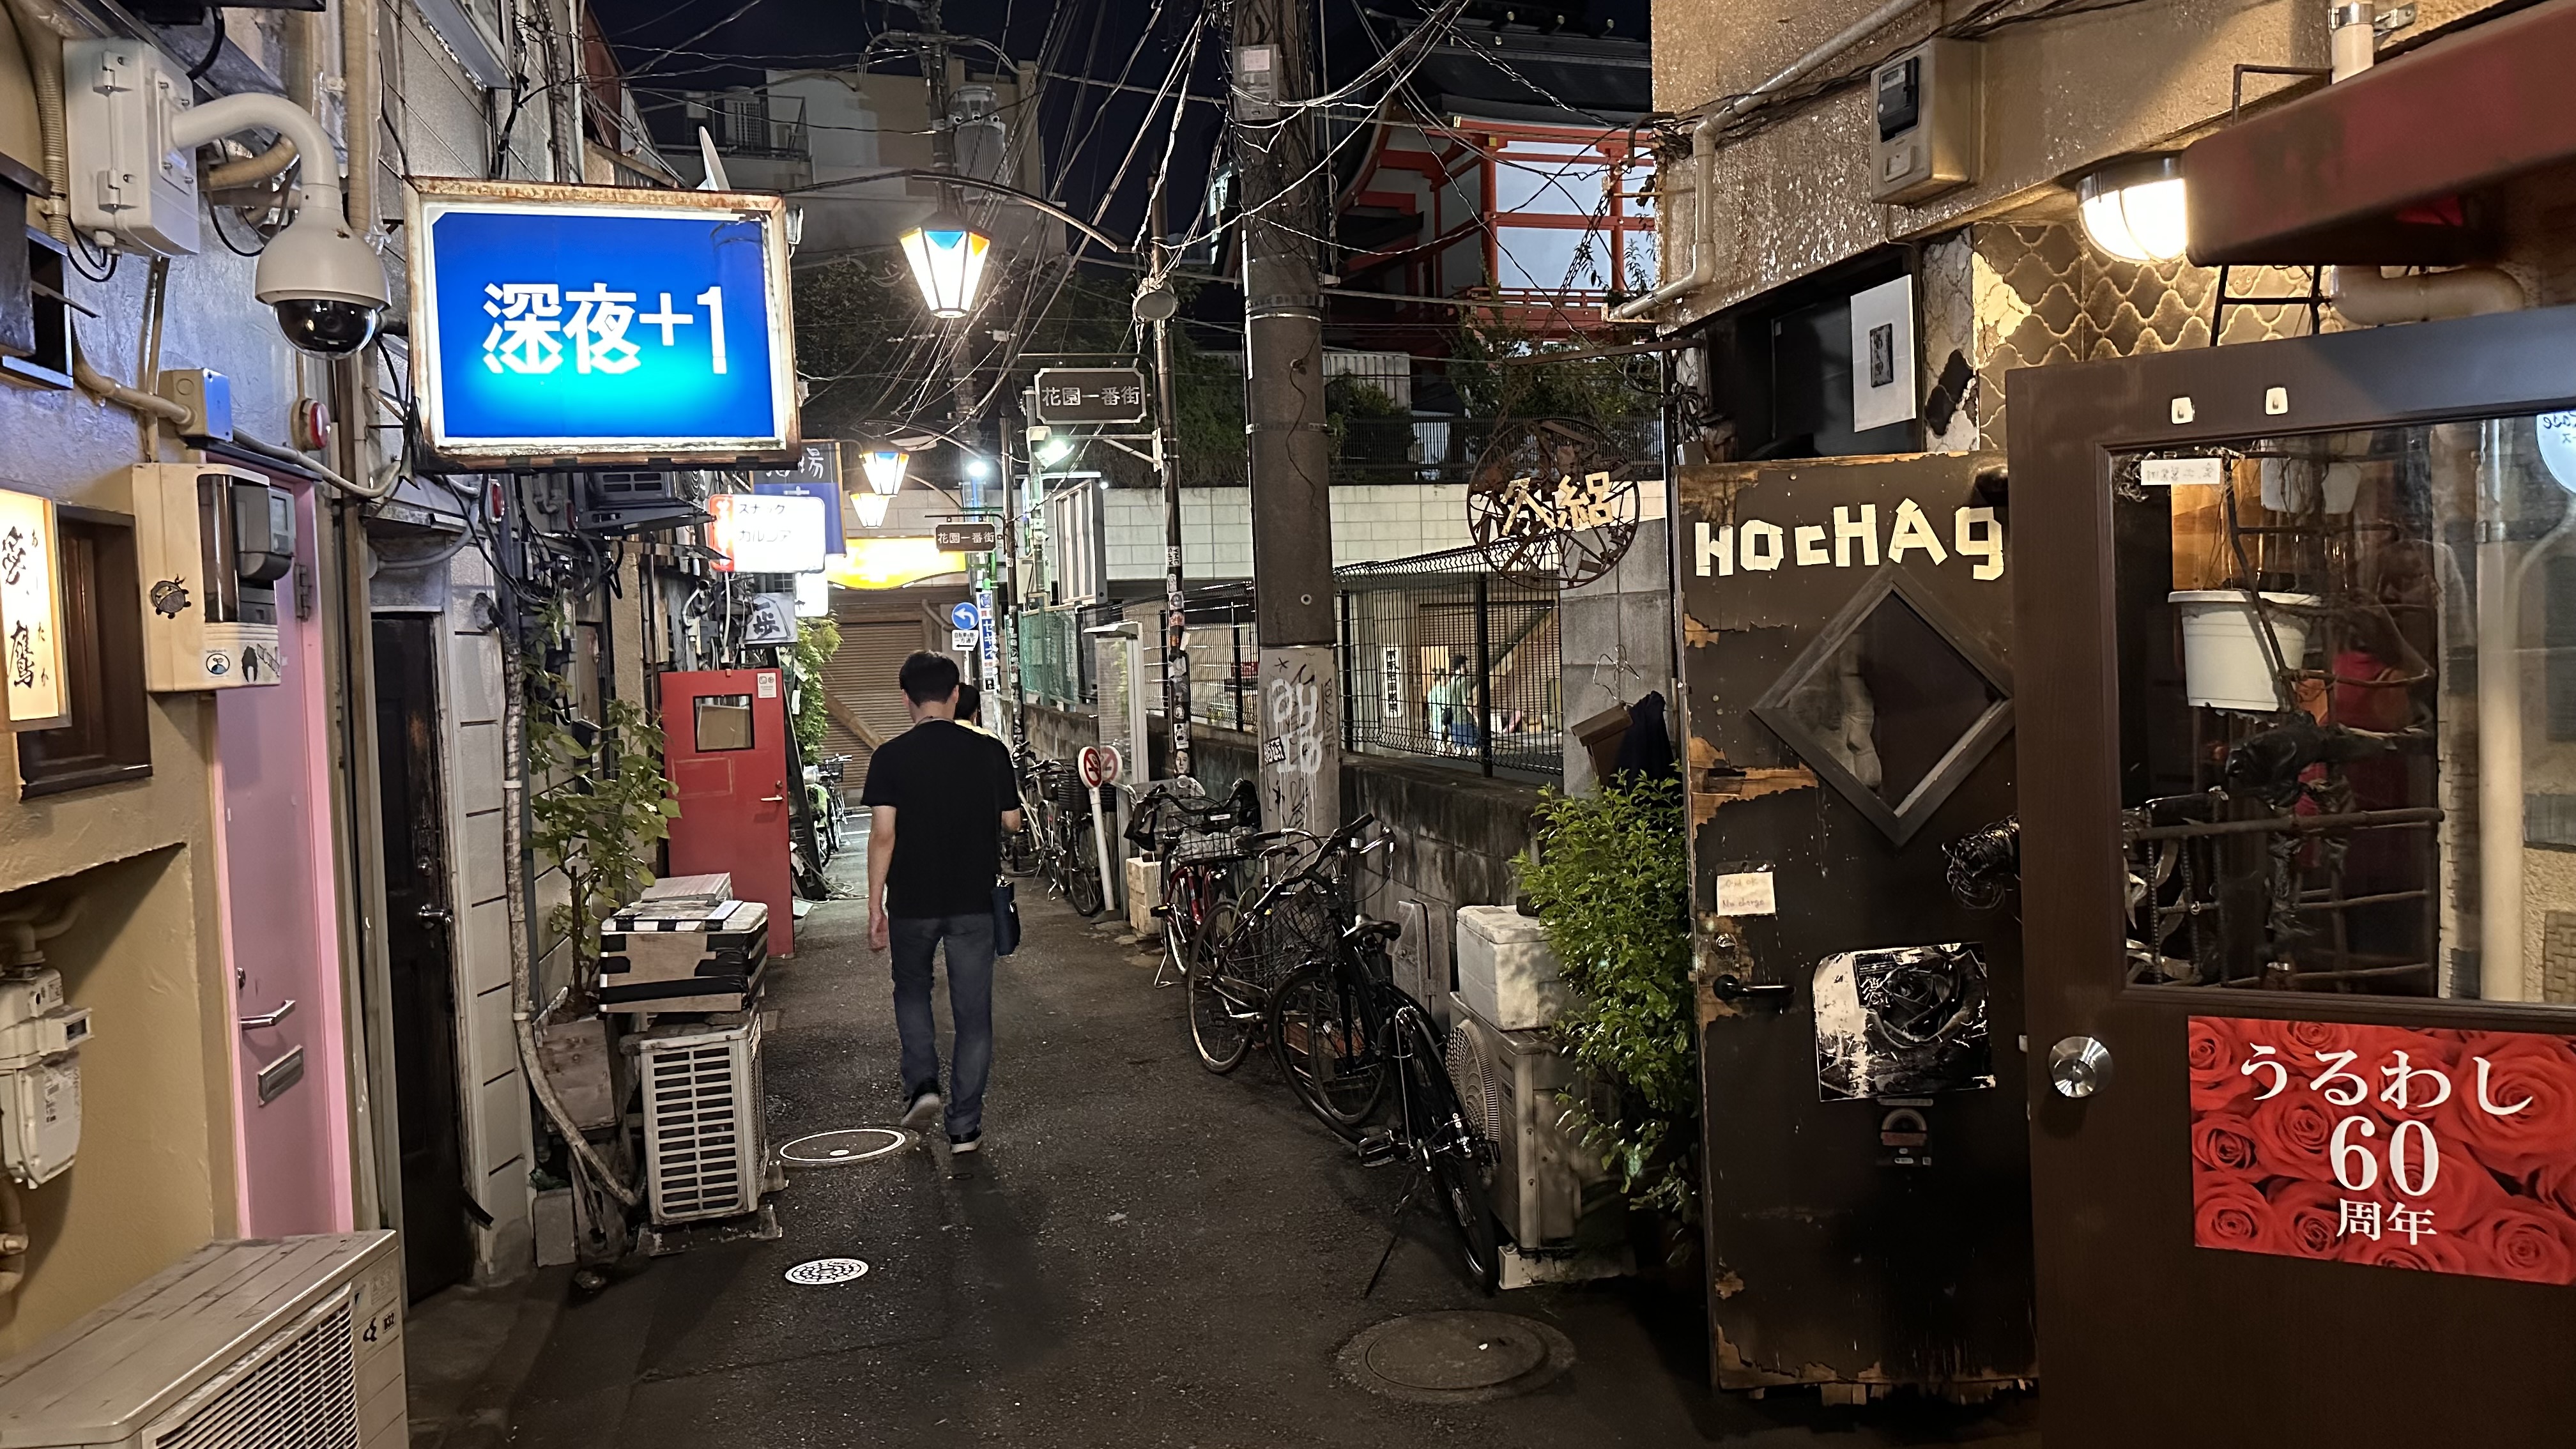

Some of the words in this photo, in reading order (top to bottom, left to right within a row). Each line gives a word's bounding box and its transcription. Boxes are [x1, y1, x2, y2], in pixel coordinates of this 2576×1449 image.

[1041, 385, 1140, 406] 花園一番街
[937, 531, 995, 544] 花園一番街
[2241, 1042, 2534, 1116] うるわし
[2330, 1116, 2440, 1197] 60
[2336, 1200, 2437, 1245] 周年
